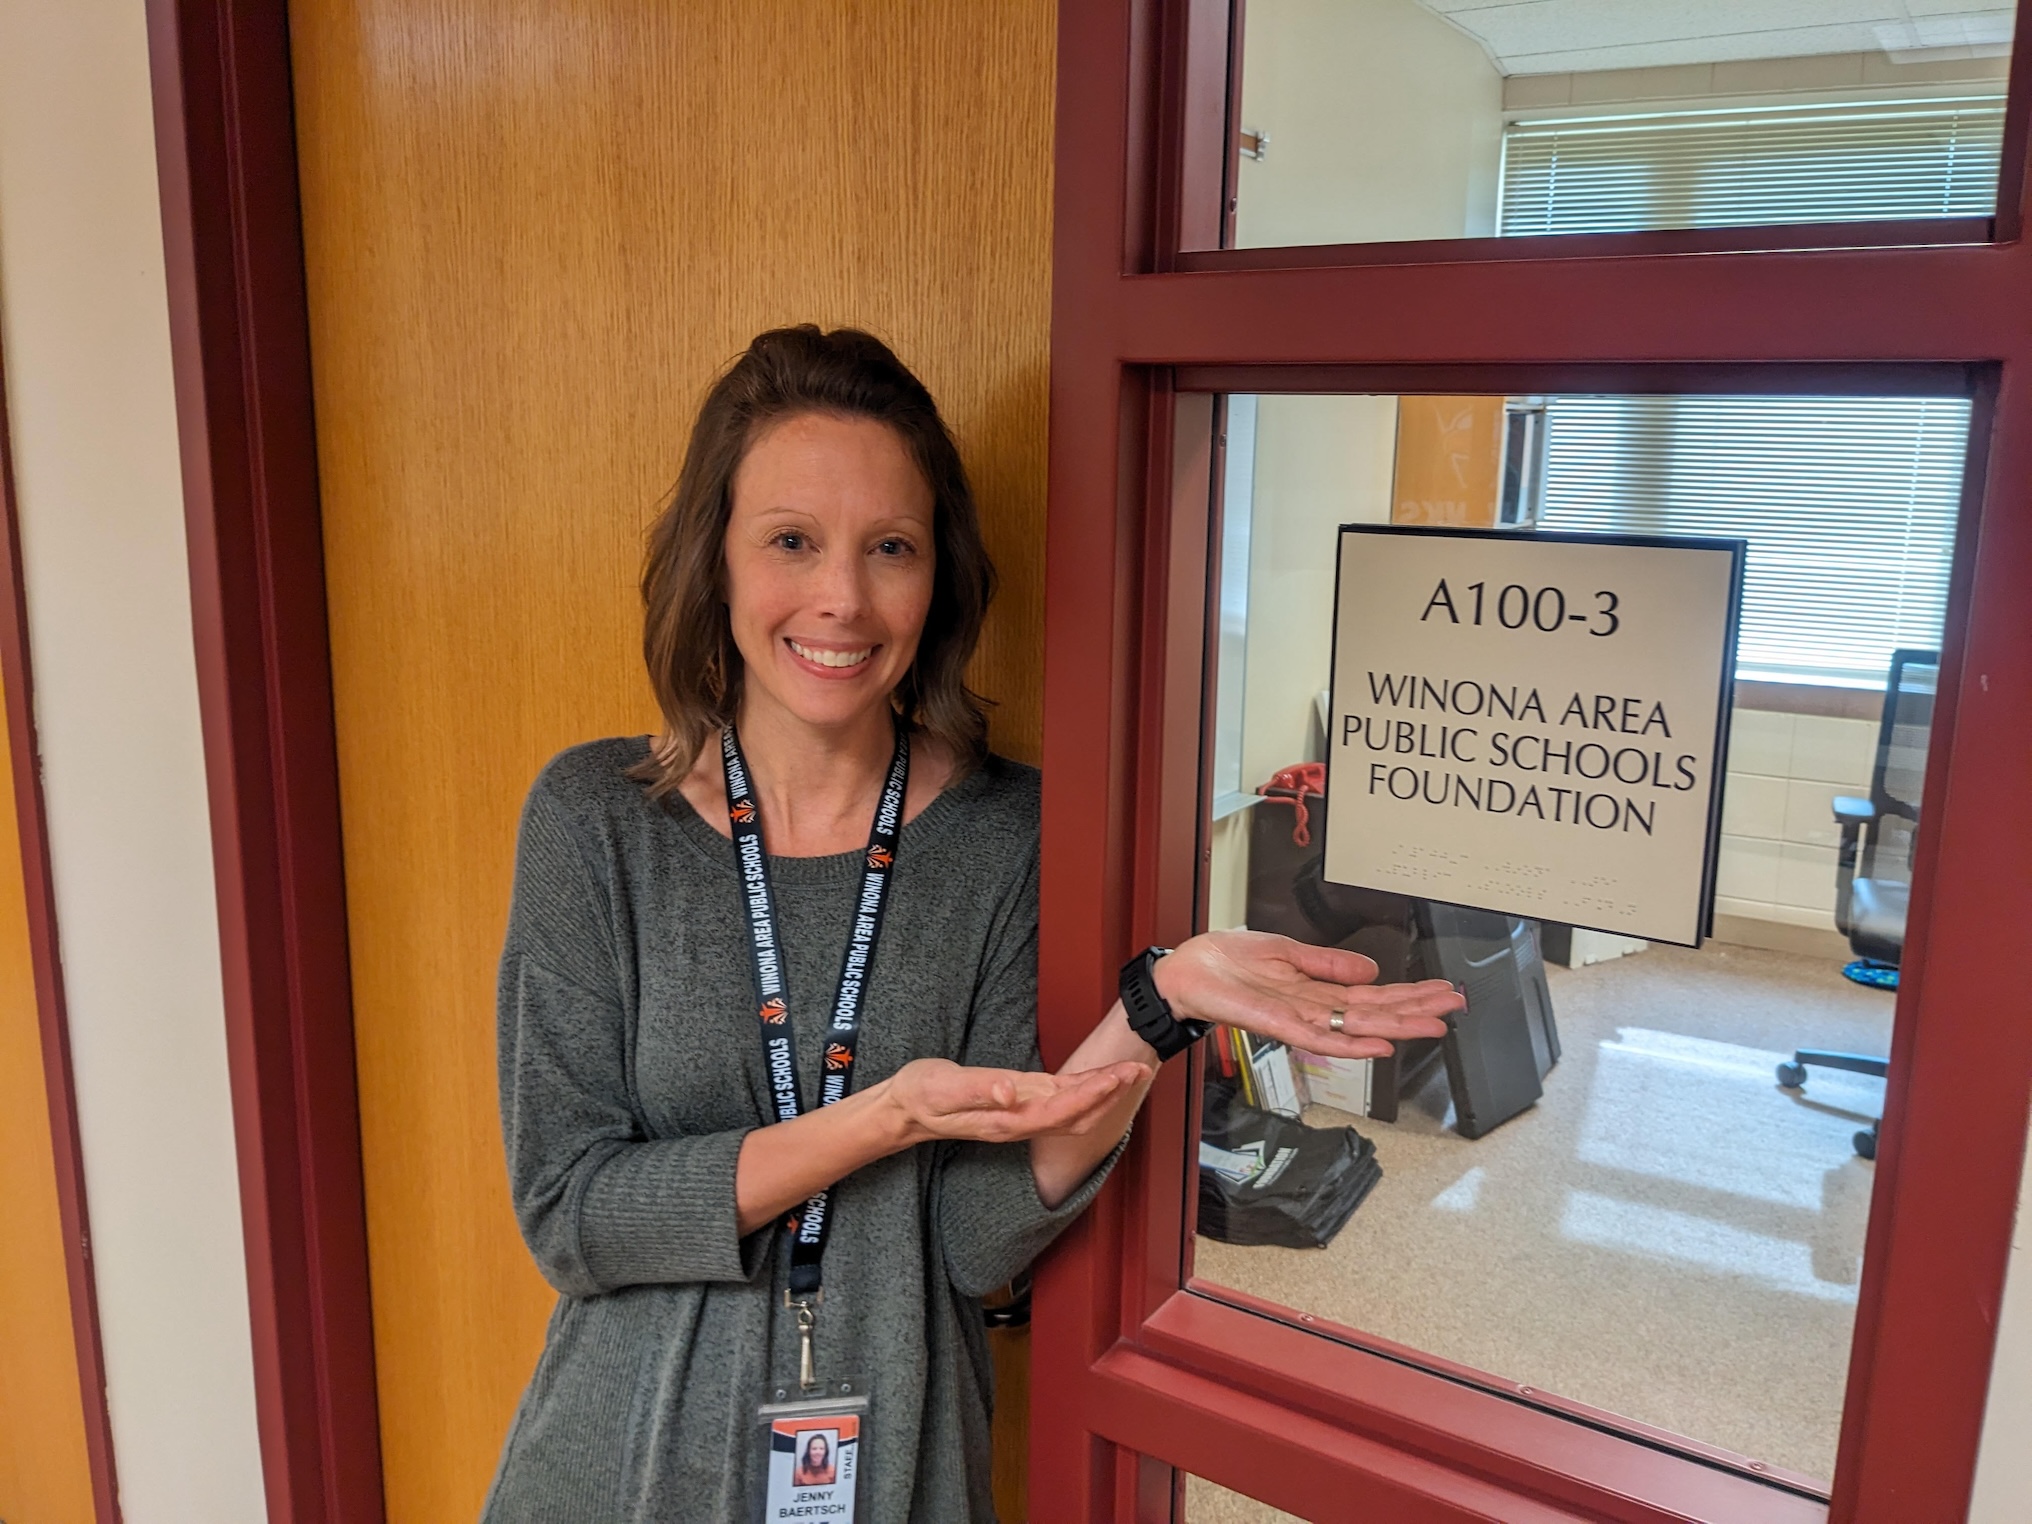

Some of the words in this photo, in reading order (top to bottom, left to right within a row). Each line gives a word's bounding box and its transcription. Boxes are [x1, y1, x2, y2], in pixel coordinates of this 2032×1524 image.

[1420, 578, 1621, 637] A100-3
[1367, 671, 1546, 724] WINONA
[1560, 691, 1672, 739] AREA
[889, 754, 907, 791] PUBLIC
[1342, 715, 1478, 763] PUBLIC
[1489, 732, 1697, 791] SCHOOLS
[726, 757, 748, 799] WINONA
[876, 789, 902, 836] SCHOOLS
[1368, 763, 1656, 836] FOUNDATION
[738, 833, 765, 882] SCHOOLS
[746, 881, 770, 919] PUBLIC
[858, 872, 885, 914] WINONA
[753, 919, 775, 948] AREA
[852, 913, 876, 943] AREA
[757, 948, 781, 996] WINONA
[844, 943, 870, 980] PUBLIC
[832, 979, 861, 1031] SCHOOLS
[768, 1037, 795, 1091] SCHOOLS
[775, 1091, 798, 1122] UBLIC
[822, 1075, 845, 1106] WINO
[799, 1191, 829, 1244] SCHOOLS
[779, 1504, 846, 1518] BAERTSCH
[793, 1491, 834, 1503] JENNY
